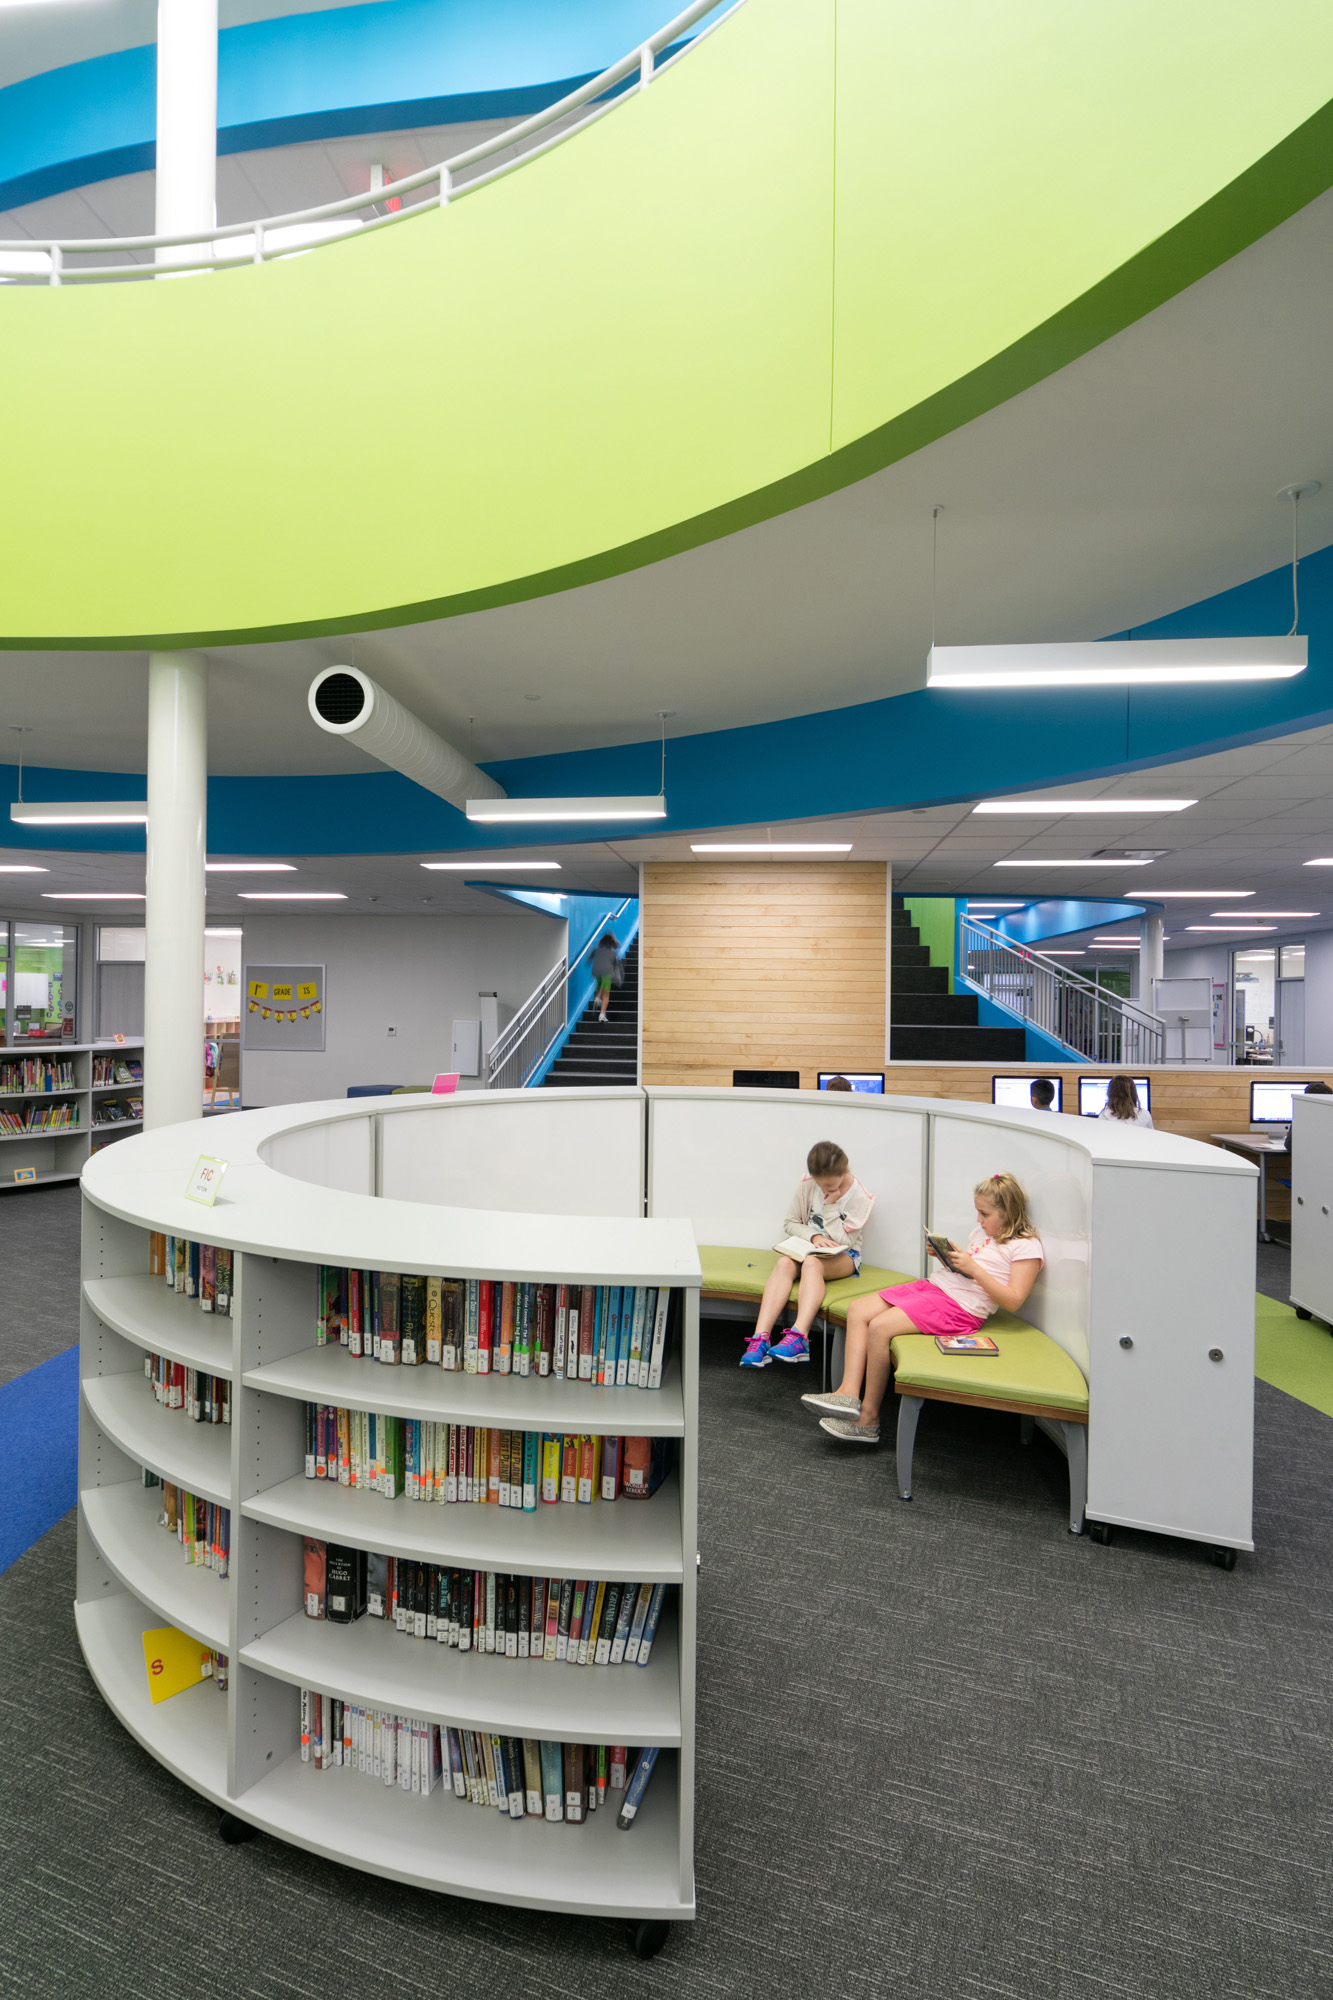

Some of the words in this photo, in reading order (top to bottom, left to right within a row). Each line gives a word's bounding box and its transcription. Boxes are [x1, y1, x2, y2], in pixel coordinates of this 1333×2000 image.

[273, 988, 291, 996] GRADE
[303, 986, 310, 994] IS
[200, 1168, 214, 1182] FIC
[429, 1299, 438, 1335] Queste
[622, 1592, 633, 1620] WELLS
[151, 1658, 164, 1676] S
